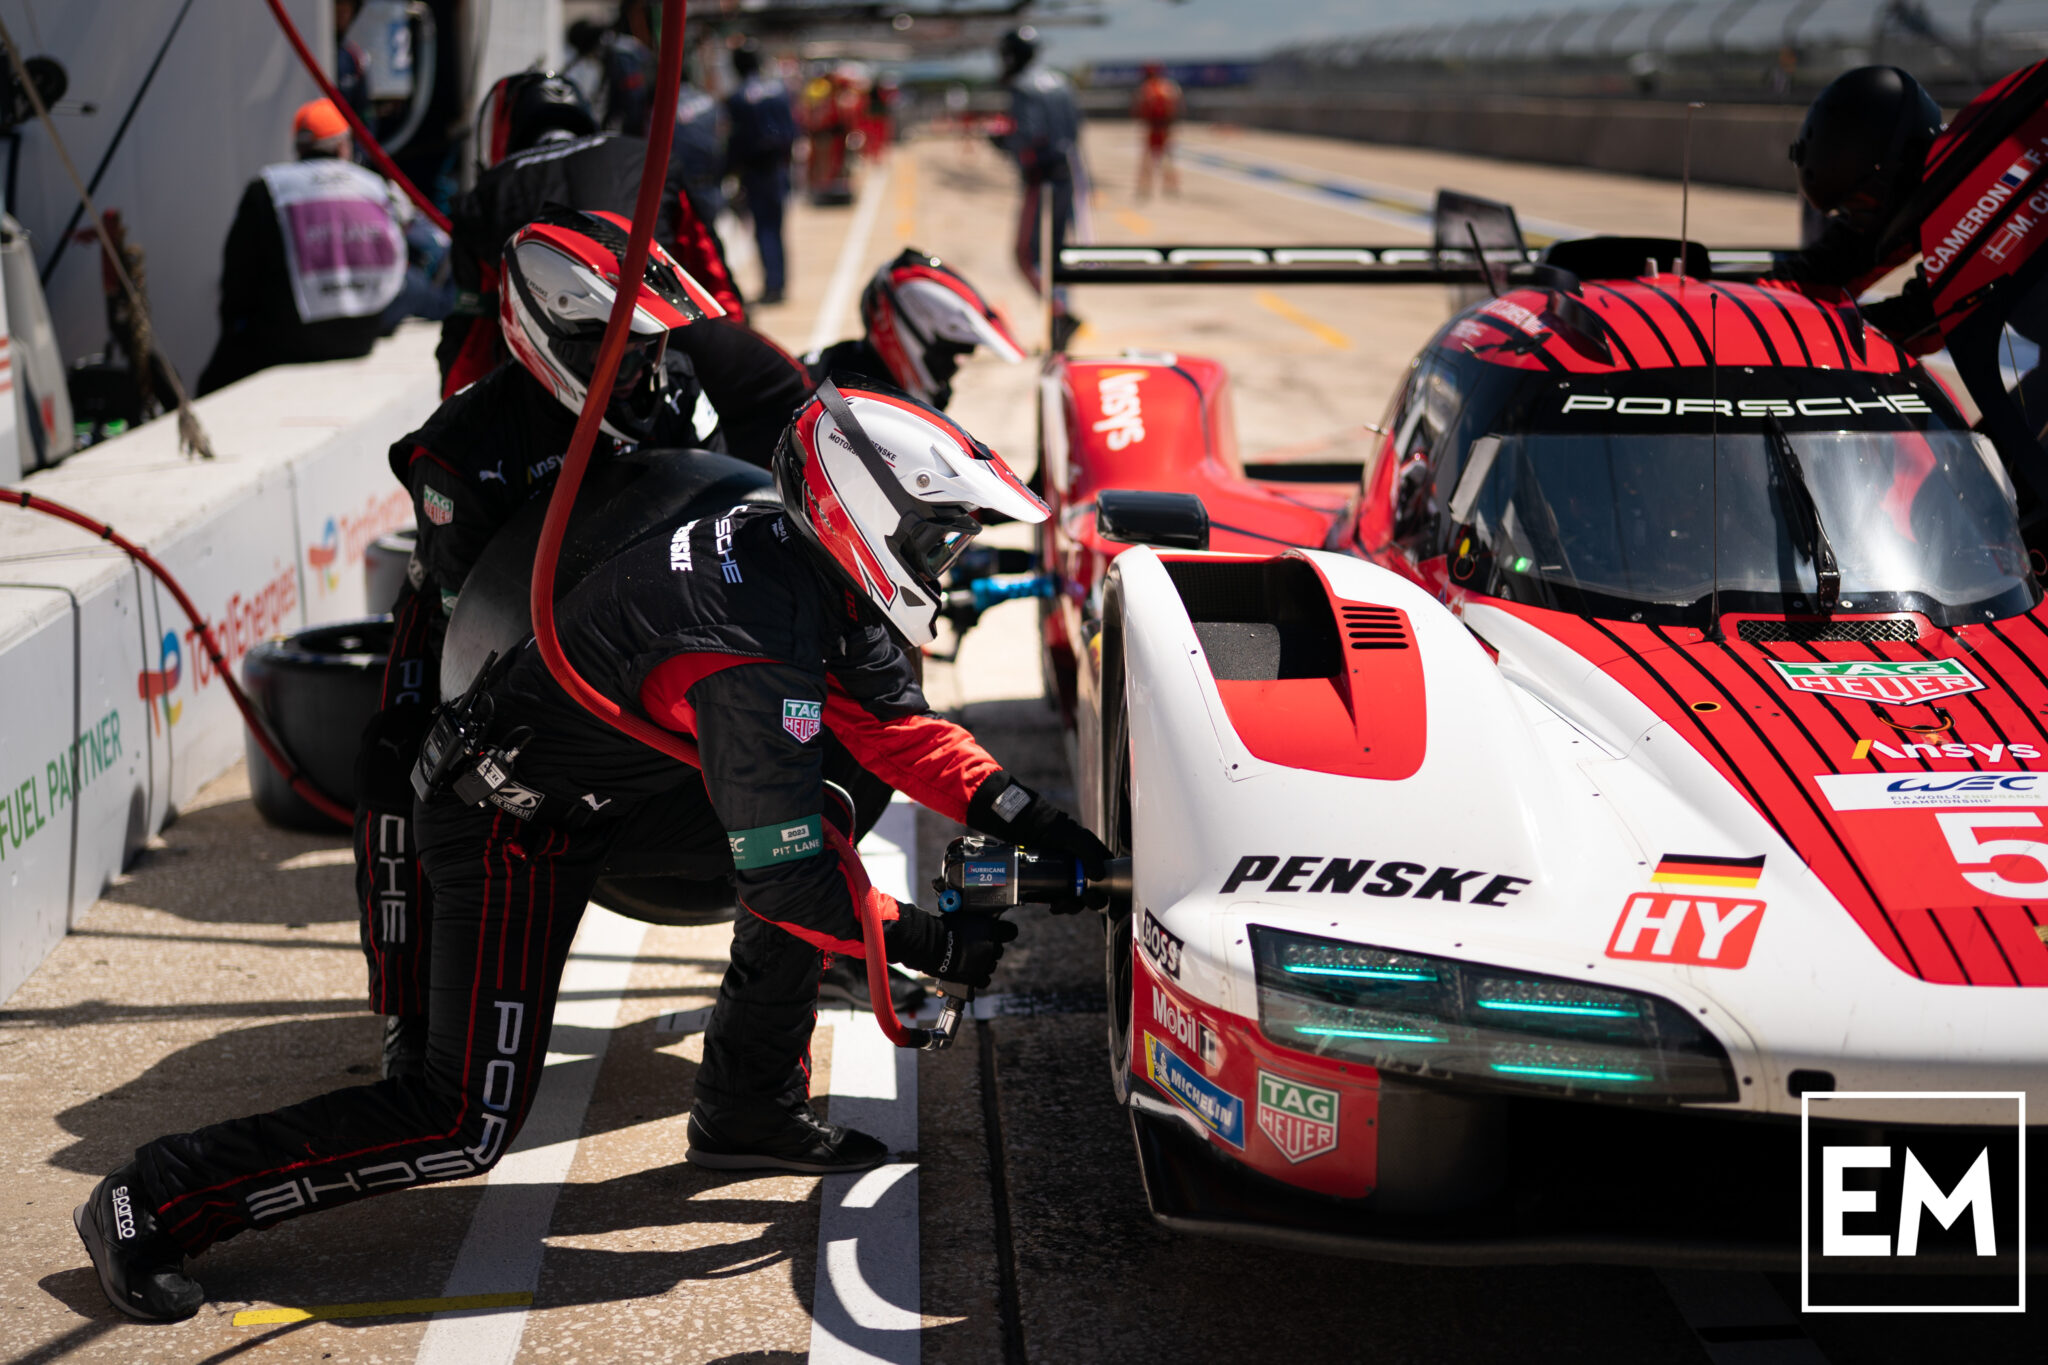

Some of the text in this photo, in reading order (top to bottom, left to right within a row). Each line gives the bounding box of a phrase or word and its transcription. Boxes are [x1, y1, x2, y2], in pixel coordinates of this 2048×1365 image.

[1923, 183, 2012, 274] CAMERON
[1092, 369, 1151, 452] Ansys
[1561, 393, 1933, 417] PORSCHE
[527, 453, 567, 485] Ansy
[872, 440, 897, 462] ENSKE
[1788, 664, 1950, 675] TAG
[1799, 677, 1969, 701] HEUER
[785, 718, 820, 740] HEUER
[787, 702, 820, 718] TAG
[1851, 739, 2042, 763] Ansys
[1886, 775, 2038, 792] WEC
[0, 774, 46, 863] FUEL
[787, 827, 807, 838] 2023
[772, 838, 821, 857] PIT LANE
[1934, 811, 2048, 900] 5
[979, 873, 993, 882] 2.0
[1218, 855, 1534, 908] PENSKE
[1144, 914, 1179, 973] BOSS
[1612, 897, 1758, 960] HY
[1152, 985, 1214, 1061] Mobil 1
[245, 1000, 525, 1221] PORSCHE
[1171, 1067, 1233, 1128] MICHELIN
[1264, 1079, 1330, 1120] TAG
[1261, 1109, 1331, 1157] HEUER
[116, 1185, 136, 1239] sparco
